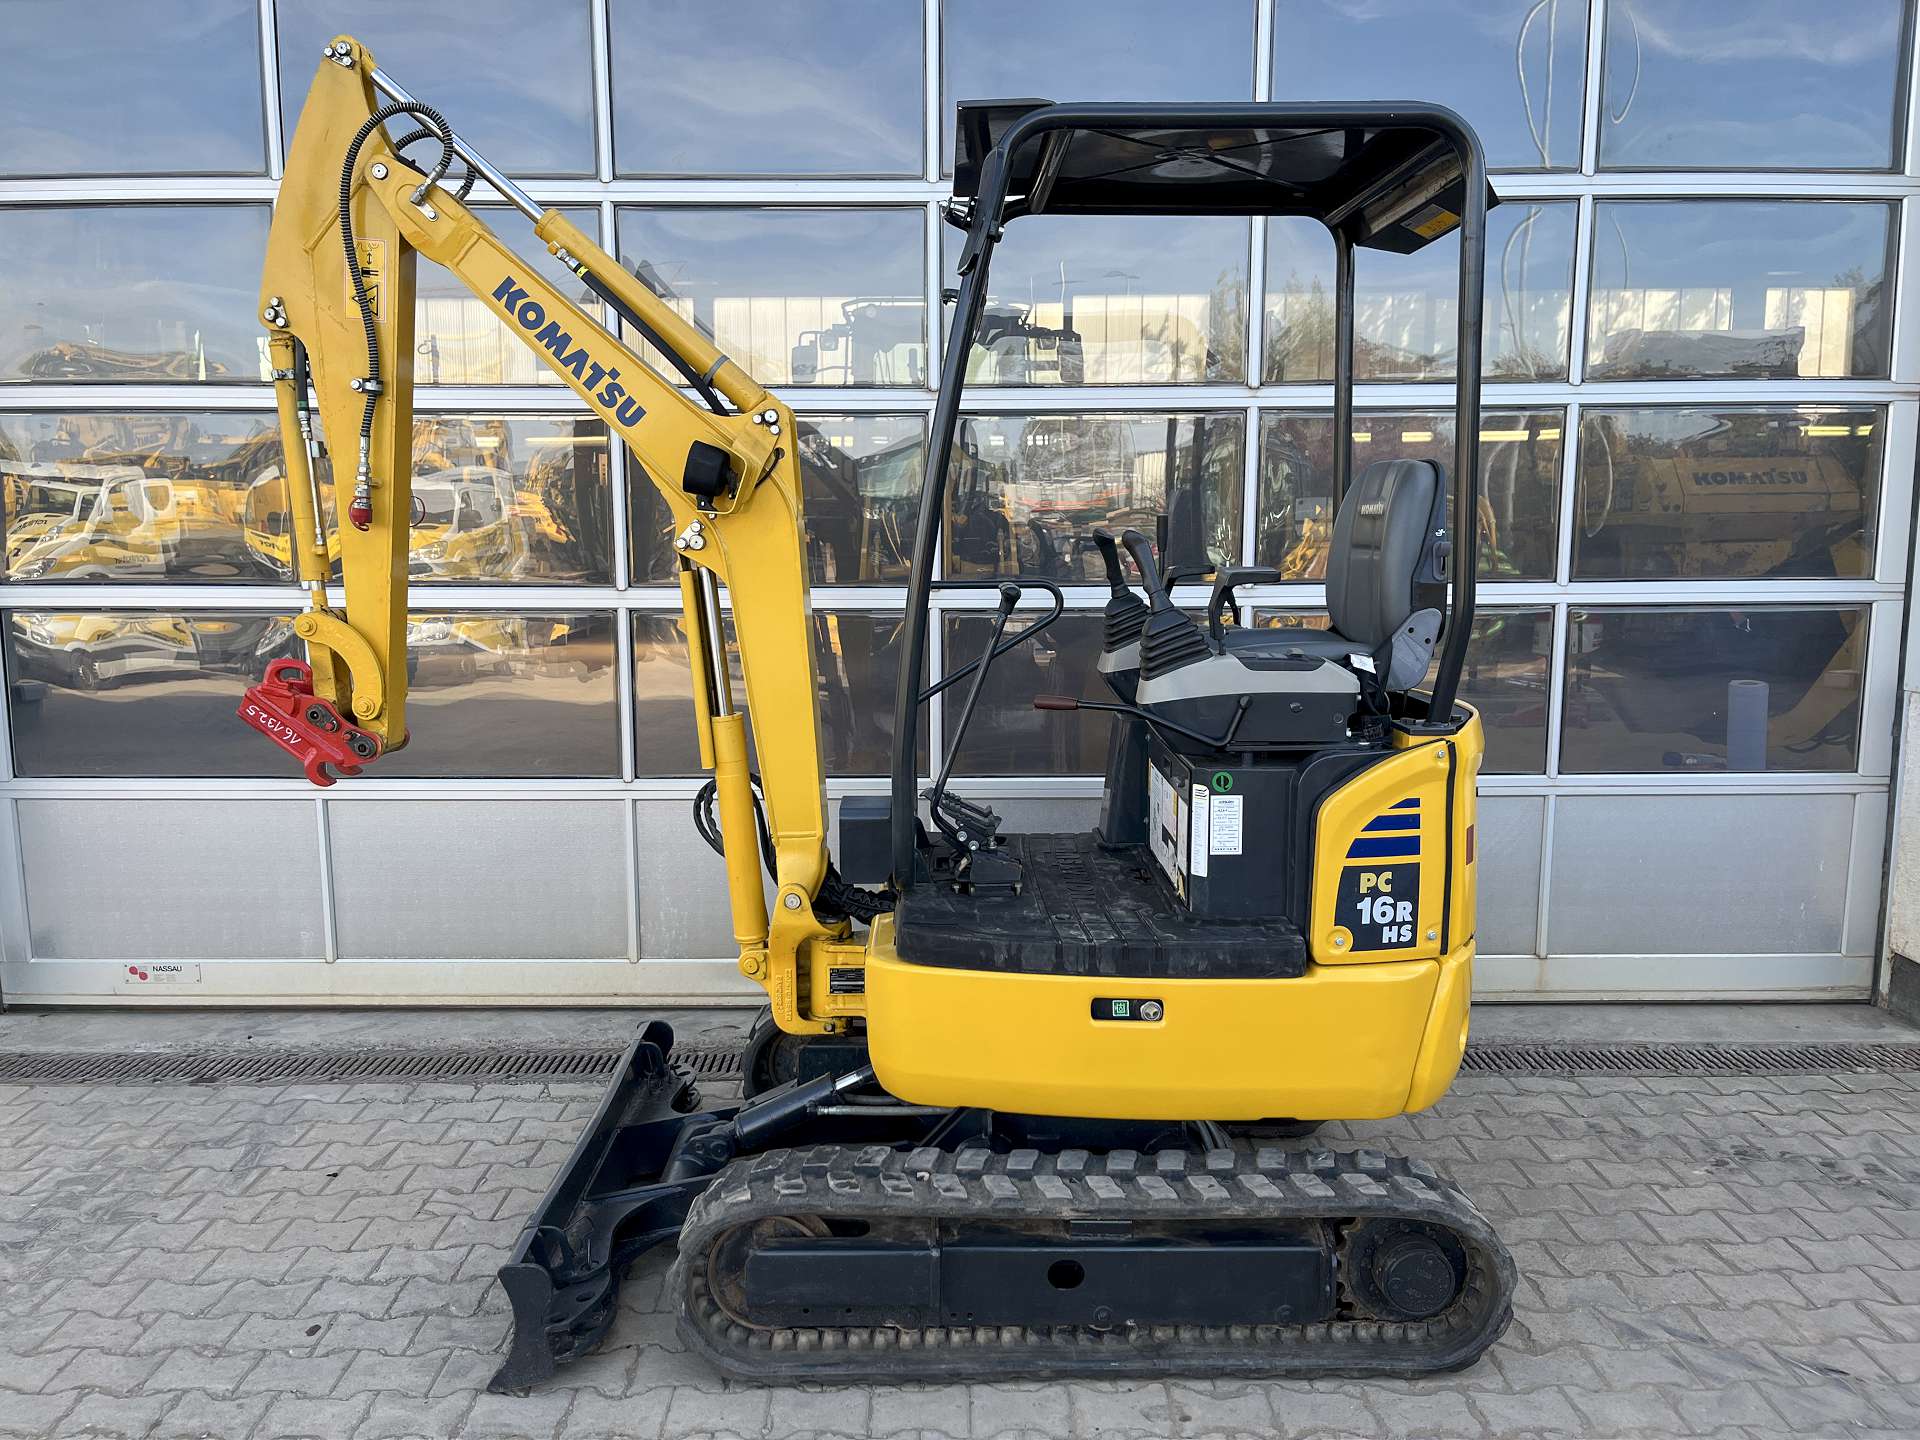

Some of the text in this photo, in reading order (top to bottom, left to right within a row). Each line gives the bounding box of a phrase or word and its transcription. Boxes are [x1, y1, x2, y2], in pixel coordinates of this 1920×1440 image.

[492, 276, 647, 427] KOMATSU
[245, 704, 302, 744] 161325
[1359, 871, 1393, 894] PC
[1356, 895, 1413, 925] 16R
[1381, 924, 1413, 944] HS
